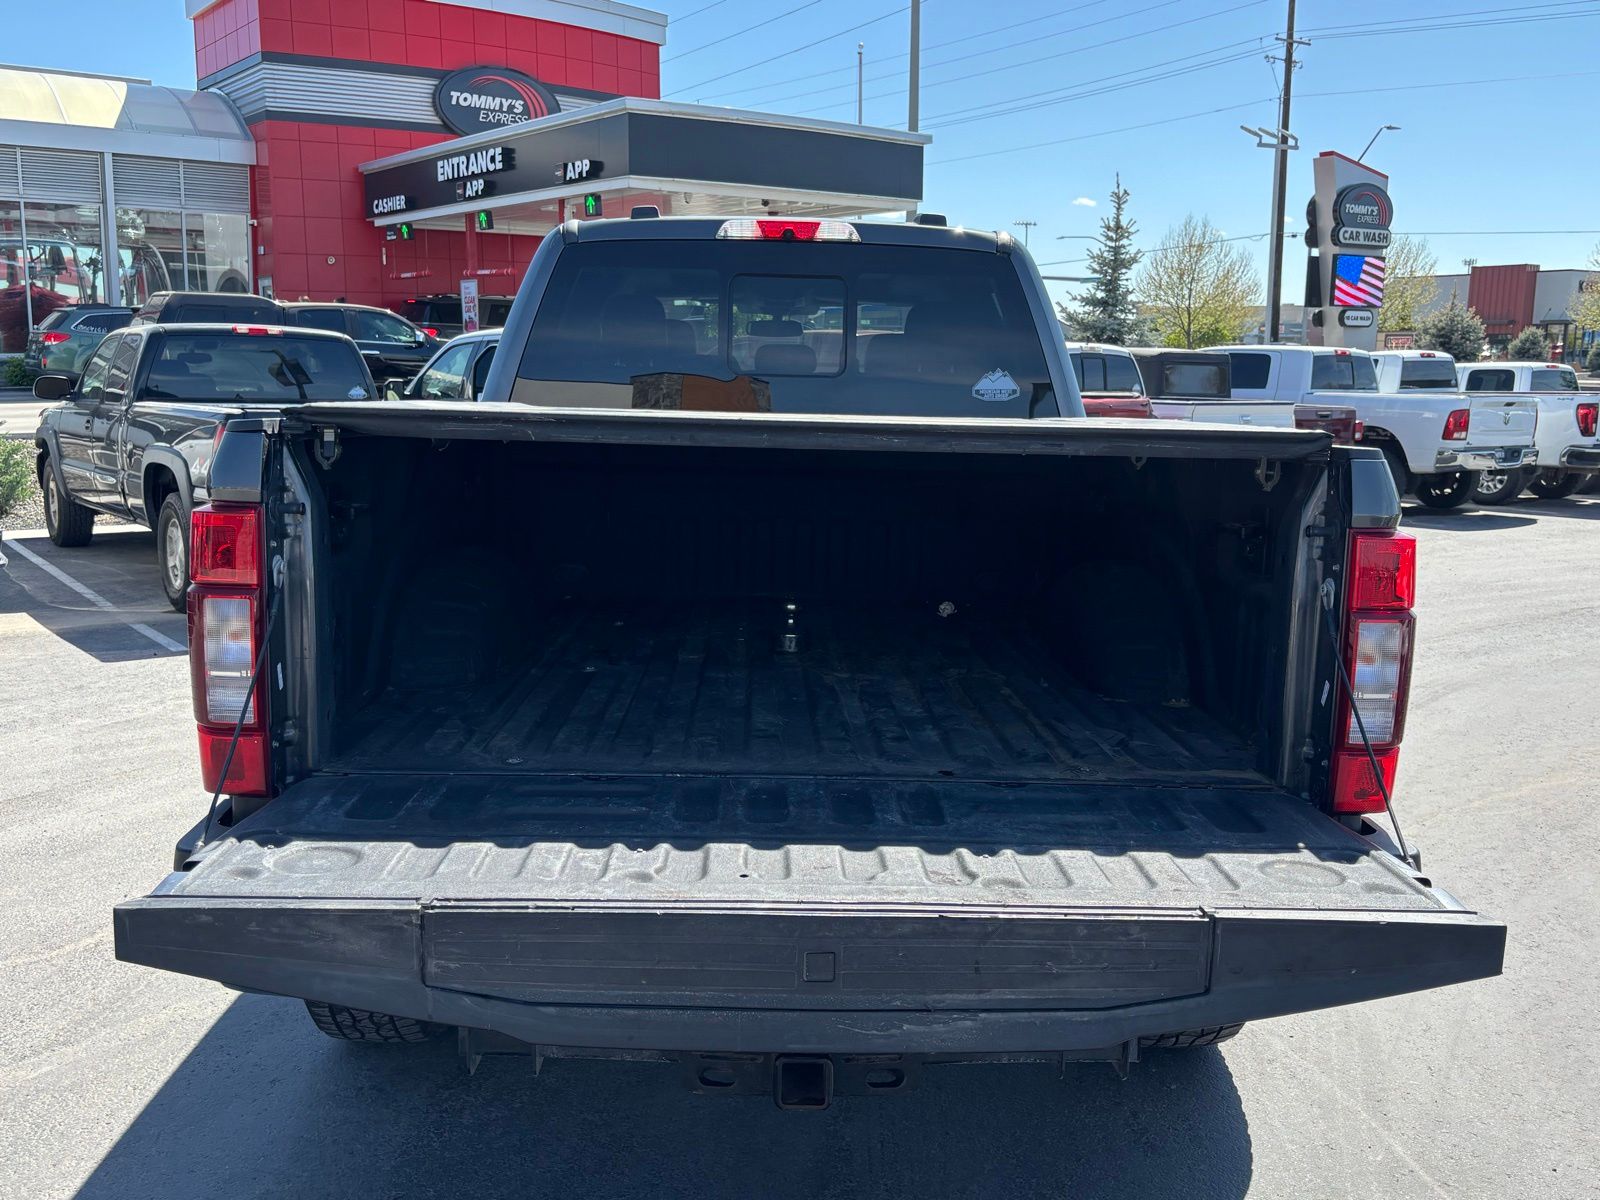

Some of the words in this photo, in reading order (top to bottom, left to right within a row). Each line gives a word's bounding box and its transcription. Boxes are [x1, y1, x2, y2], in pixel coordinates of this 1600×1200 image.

[450, 91, 524, 114] TOMMY'S
[437, 146, 503, 182] ENTRANCE
[566, 159, 590, 181] APP
[465, 179, 484, 198] APP
[373, 195, 406, 214] CASHIER
[1345, 203, 1379, 216] TOMMY'S
[1357, 215, 1379, 224] EXPRESS
[1342, 230, 1361, 242] CAR
[1363, 231, 1389, 244] WASH
